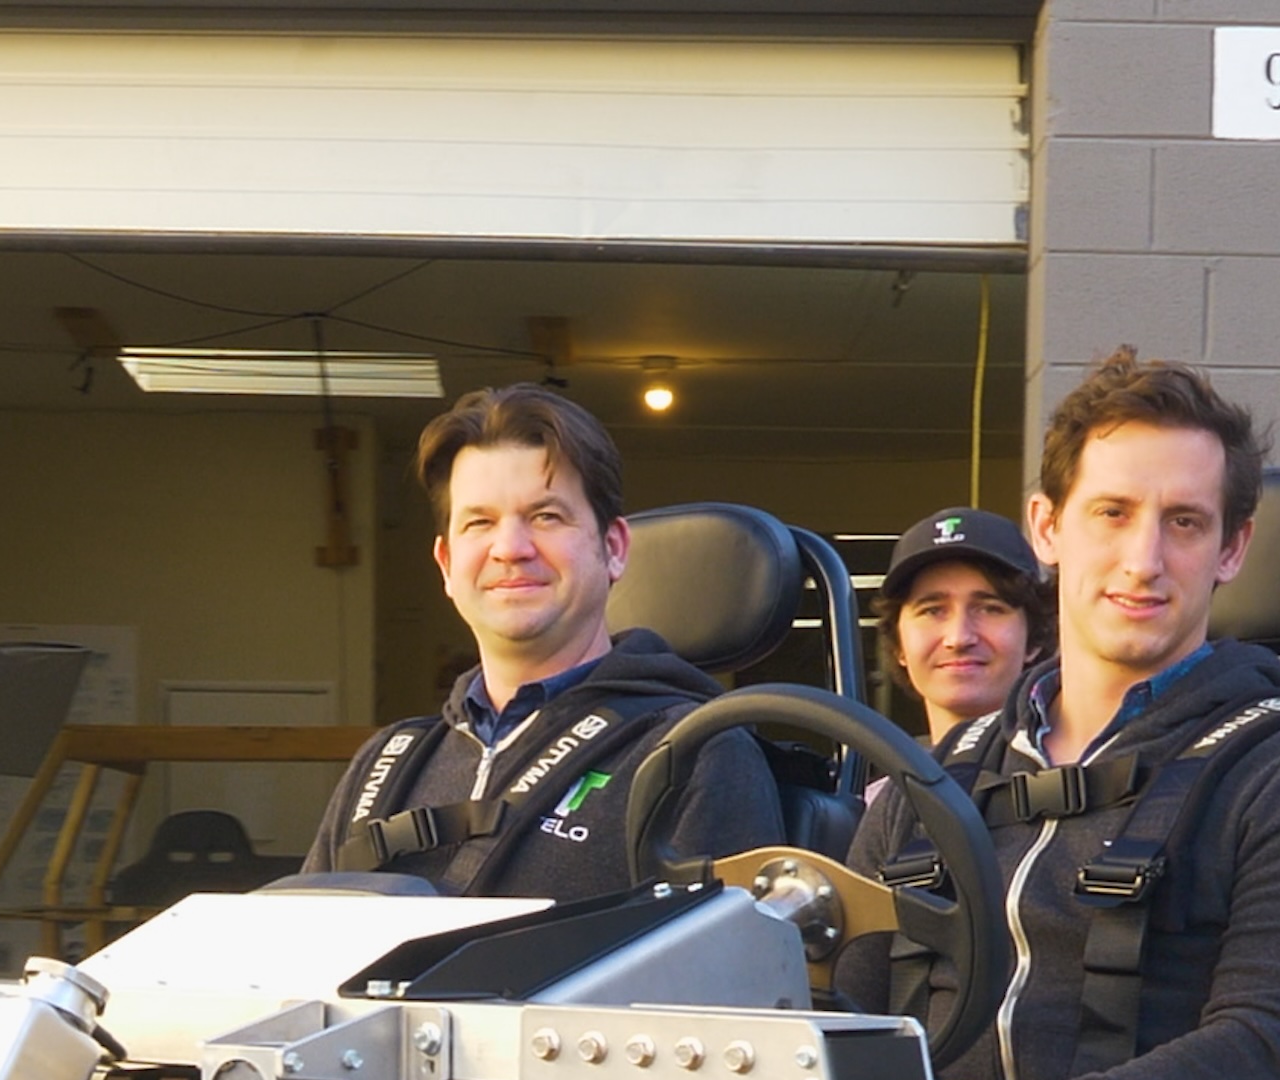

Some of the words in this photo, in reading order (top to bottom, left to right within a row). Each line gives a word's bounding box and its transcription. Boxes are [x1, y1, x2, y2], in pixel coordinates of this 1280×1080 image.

[352, 758, 396, 823] UTVMA
[510, 737, 579, 794] UTVMA
[540, 816, 589, 842] ELO
